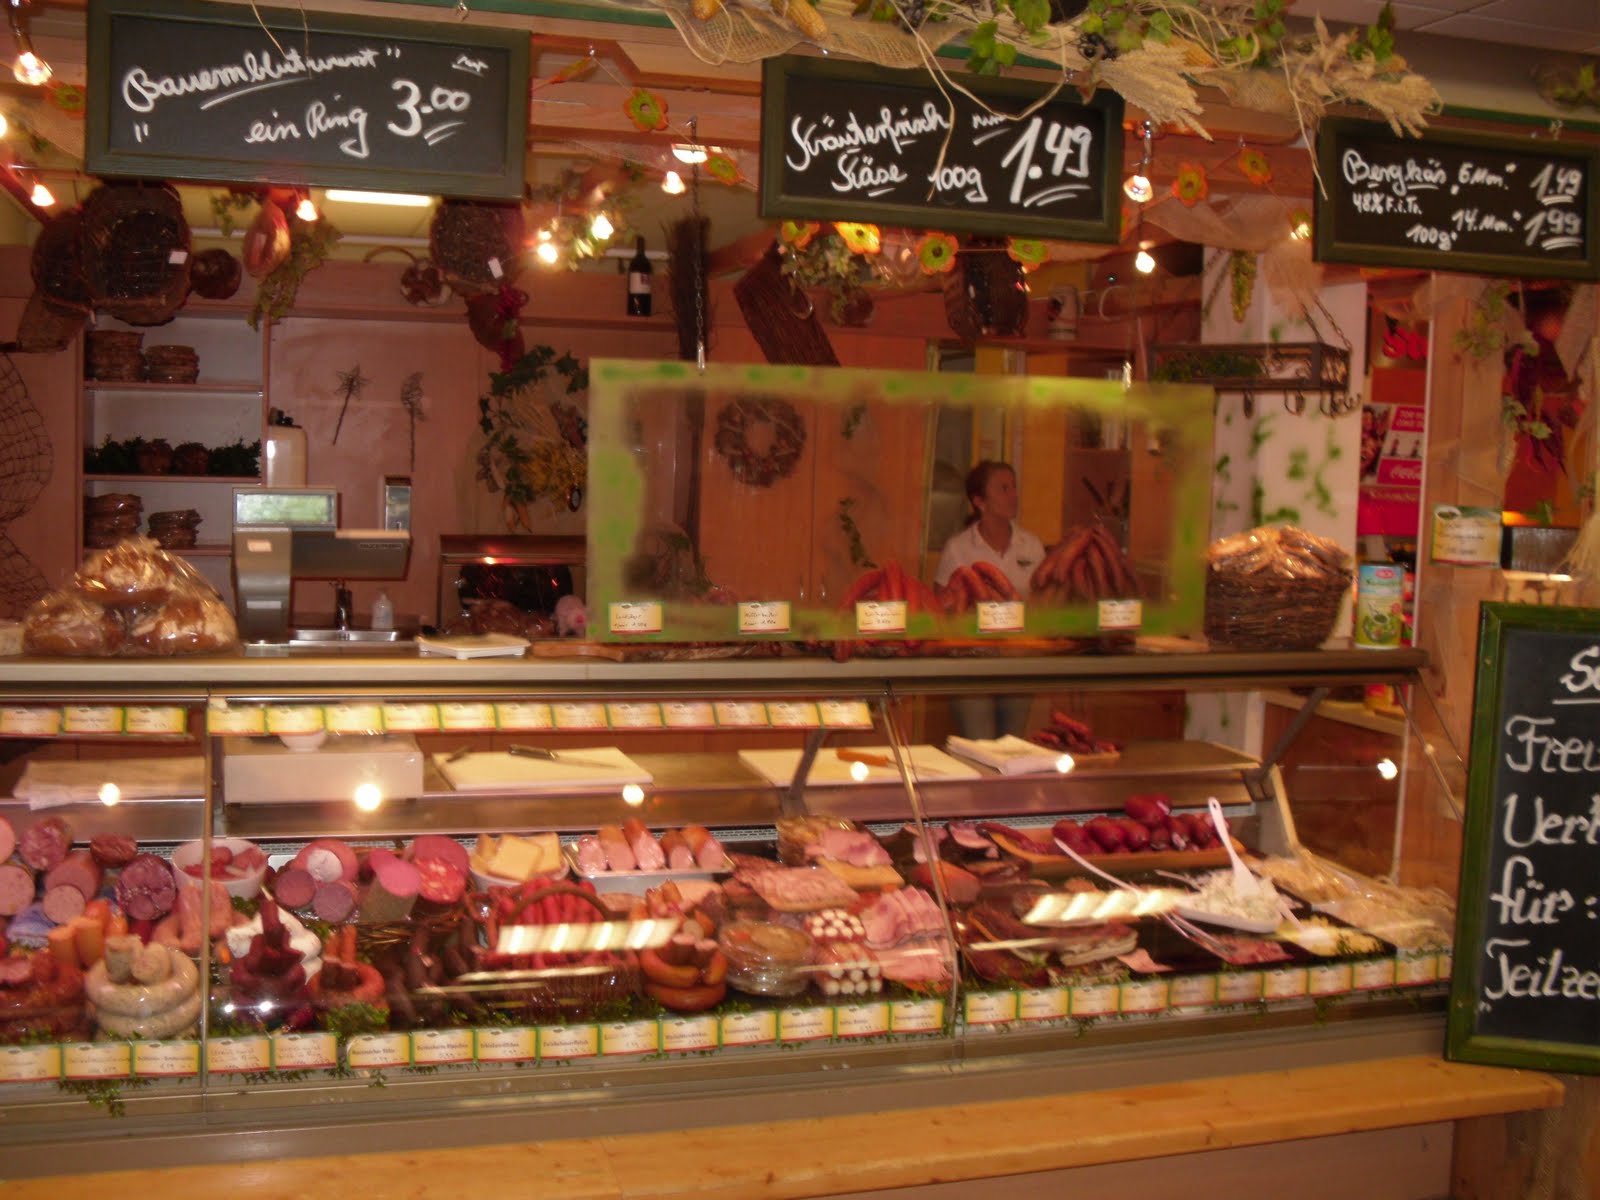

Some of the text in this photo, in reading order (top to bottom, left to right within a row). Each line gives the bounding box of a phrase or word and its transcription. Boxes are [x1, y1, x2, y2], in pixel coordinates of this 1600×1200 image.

[244, 93, 370, 158] ein Ring
[831, 154, 908, 192] Käse
[1001, 116, 1093, 204] 1.49
[1529, 163, 1583, 201] 1.49
[1406, 223, 1452, 252] 100g
[1523, 208, 1582, 247] 1.99
